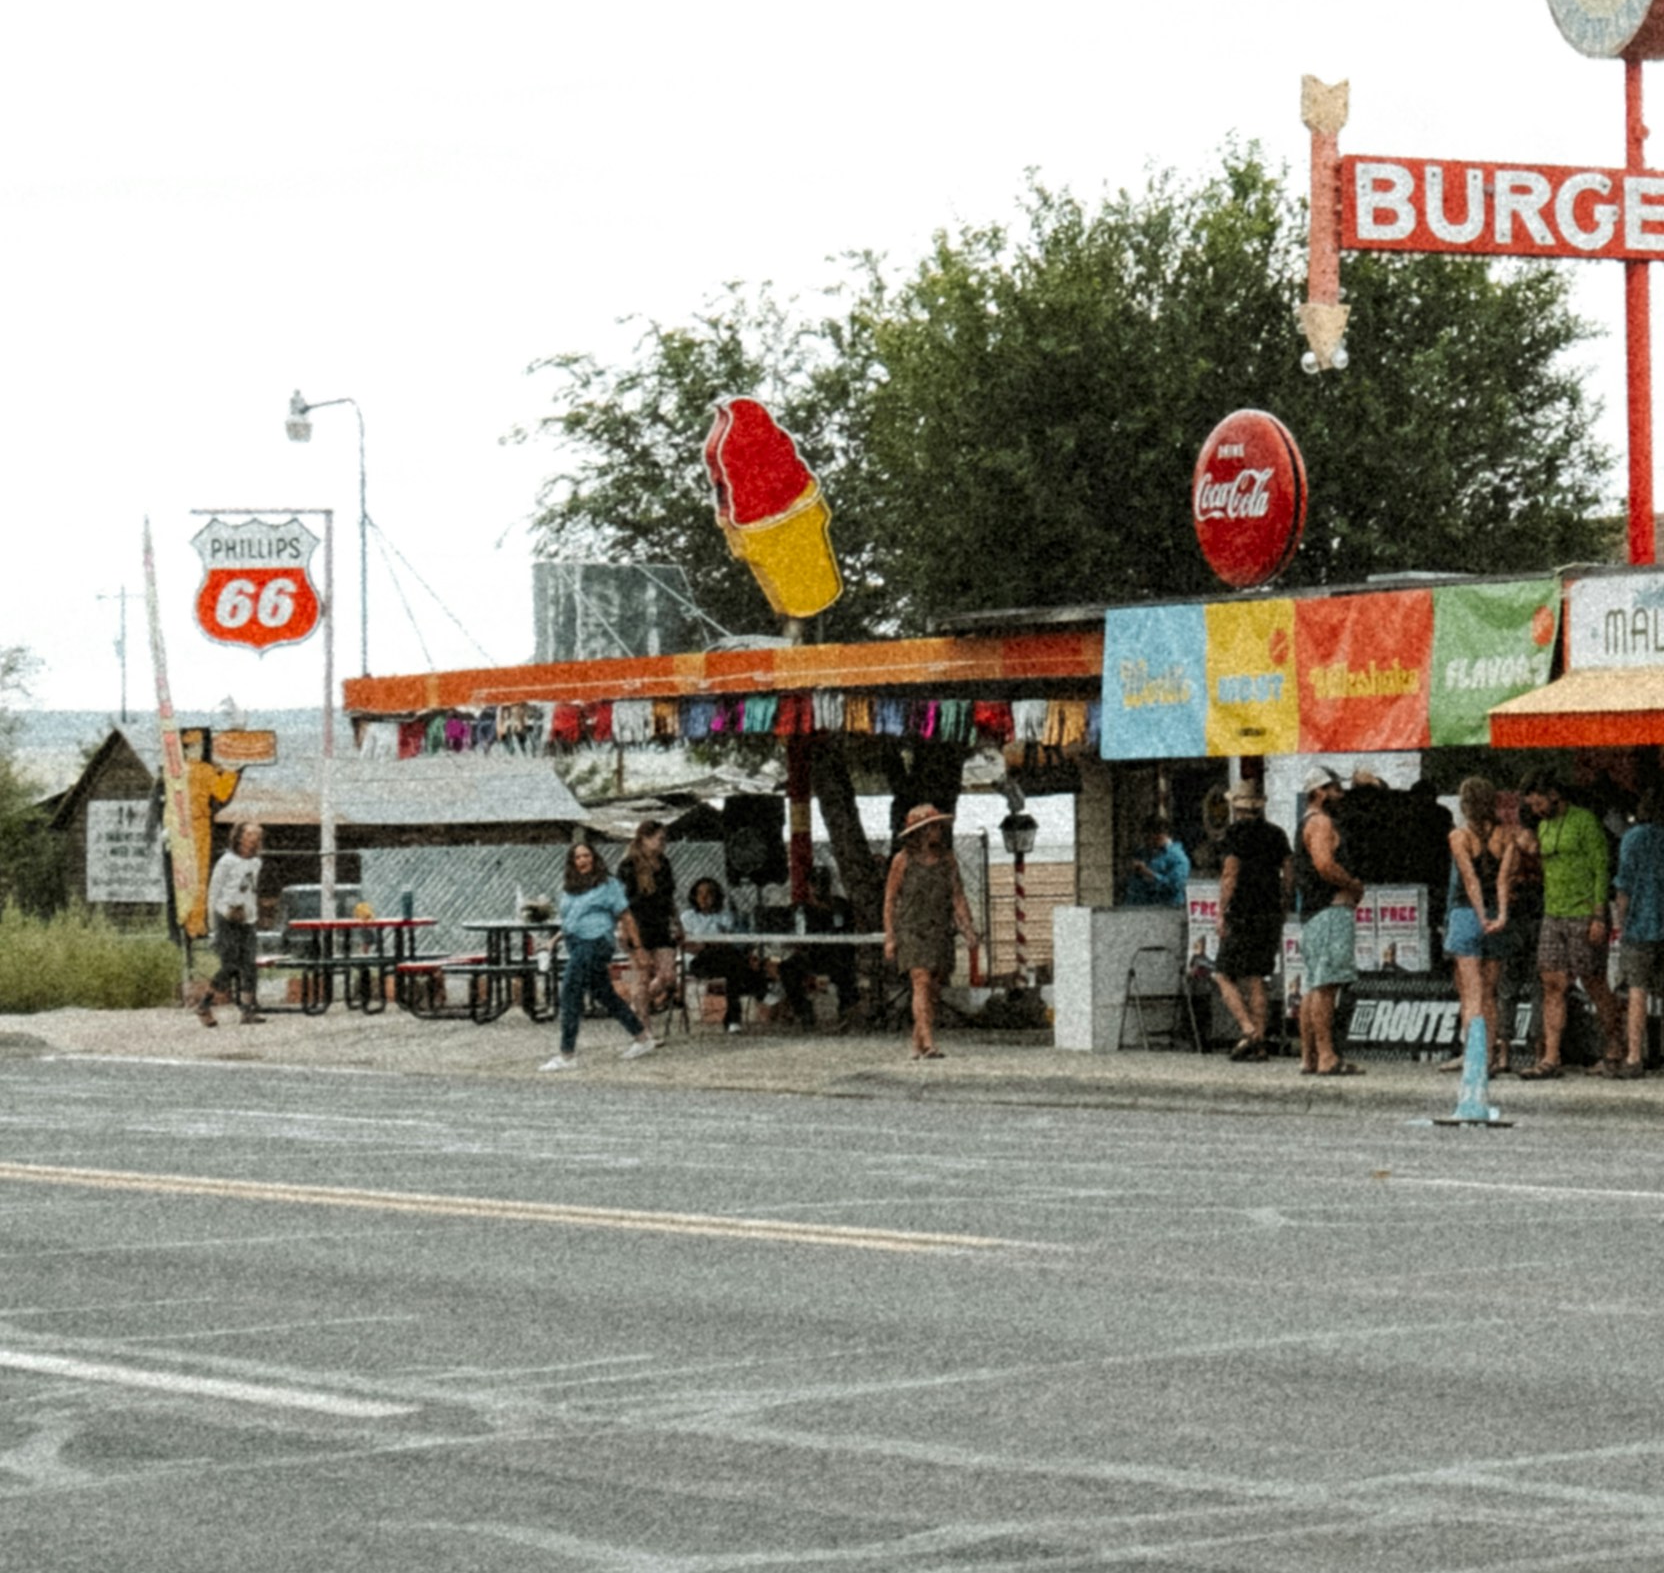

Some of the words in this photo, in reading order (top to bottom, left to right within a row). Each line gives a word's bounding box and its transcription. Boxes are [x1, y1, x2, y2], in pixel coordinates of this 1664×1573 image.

[210, 537, 301, 559] PHILLIPS
[215, 578, 297, 629] 66
[1218, 674, 1284, 703] MOST
[1190, 901, 1218, 917] FRE
[1380, 906, 1417, 923] FREE
[1369, 1000, 1462, 1043] ROUTE
